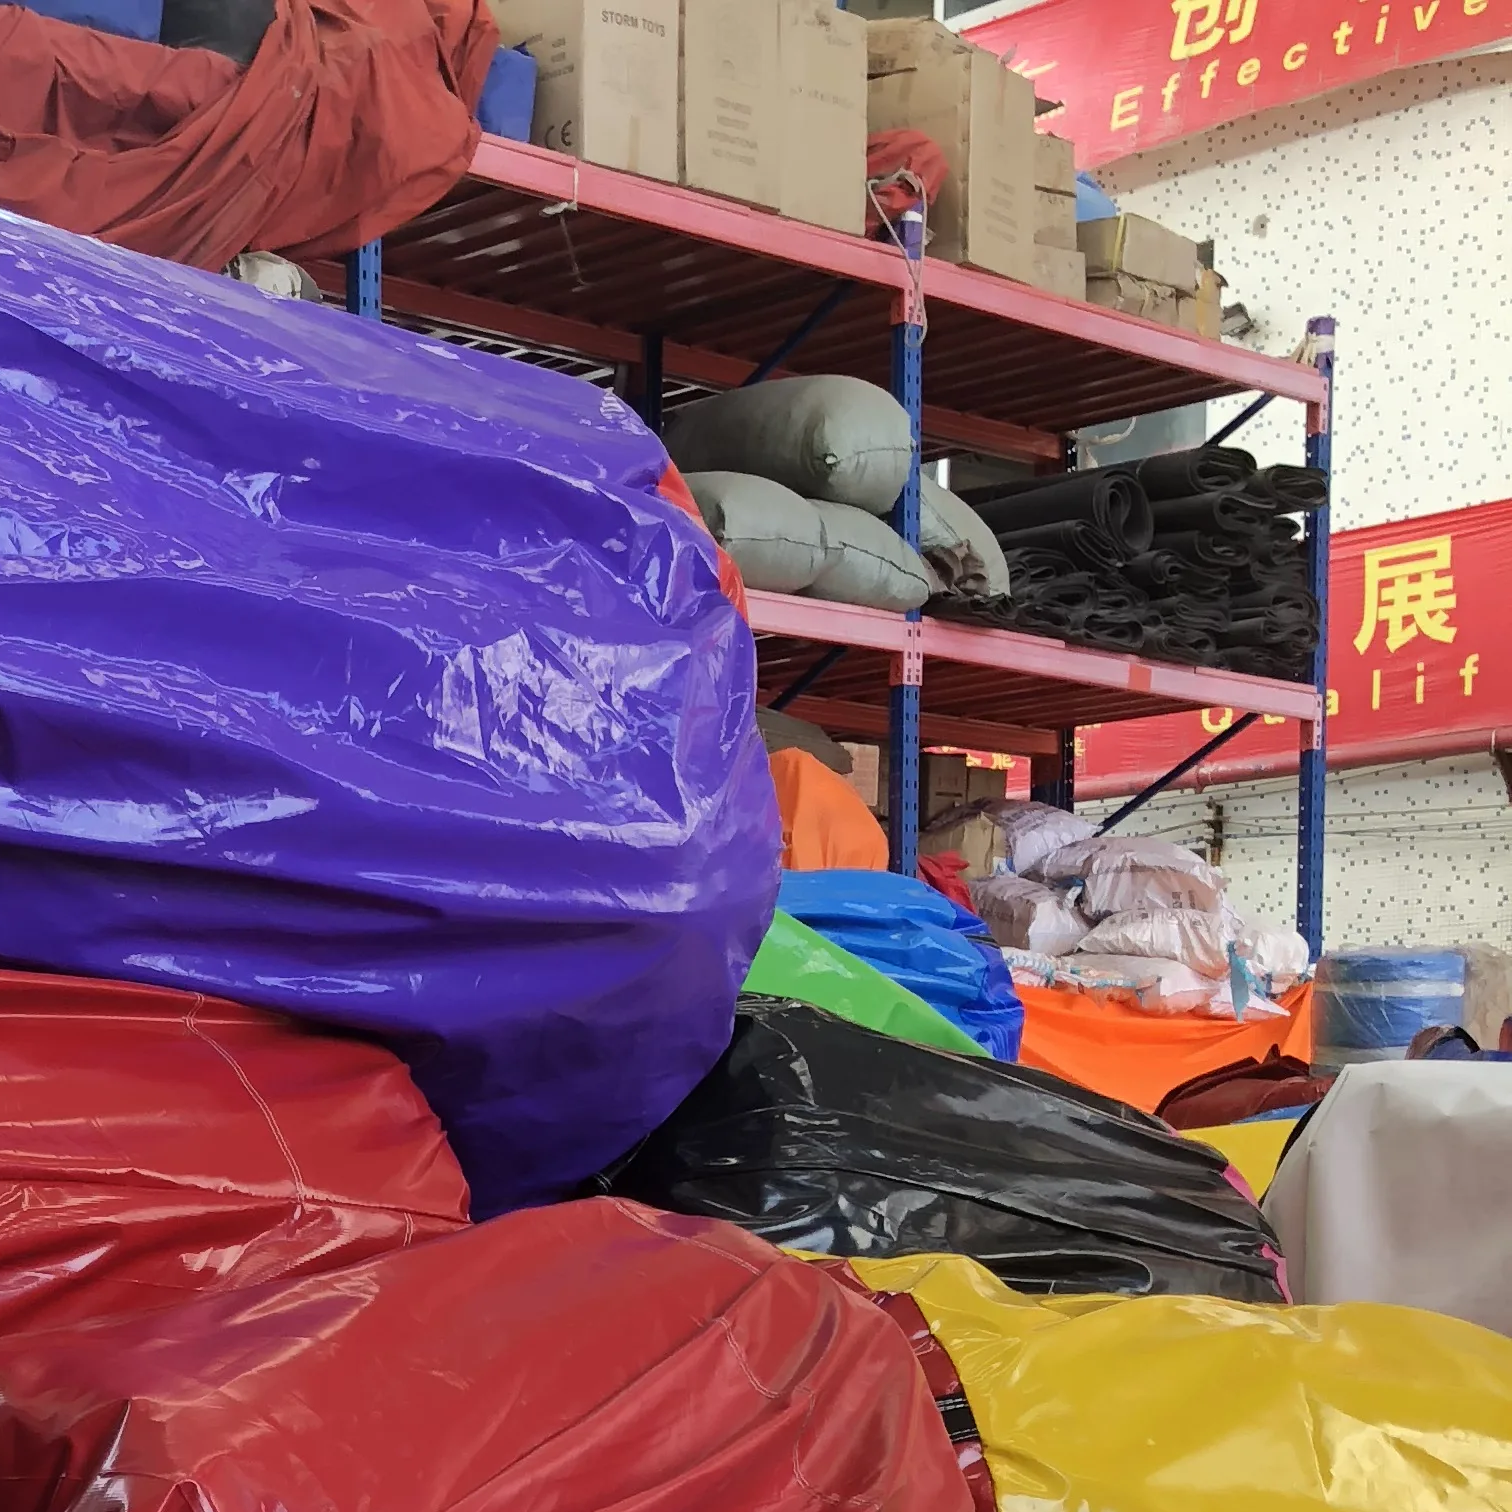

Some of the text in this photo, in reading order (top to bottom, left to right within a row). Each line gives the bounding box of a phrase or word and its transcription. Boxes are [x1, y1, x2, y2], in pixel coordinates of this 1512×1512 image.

[601, 10, 666, 37] STORM TOYS
[1353, 535, 1457, 655] 展
